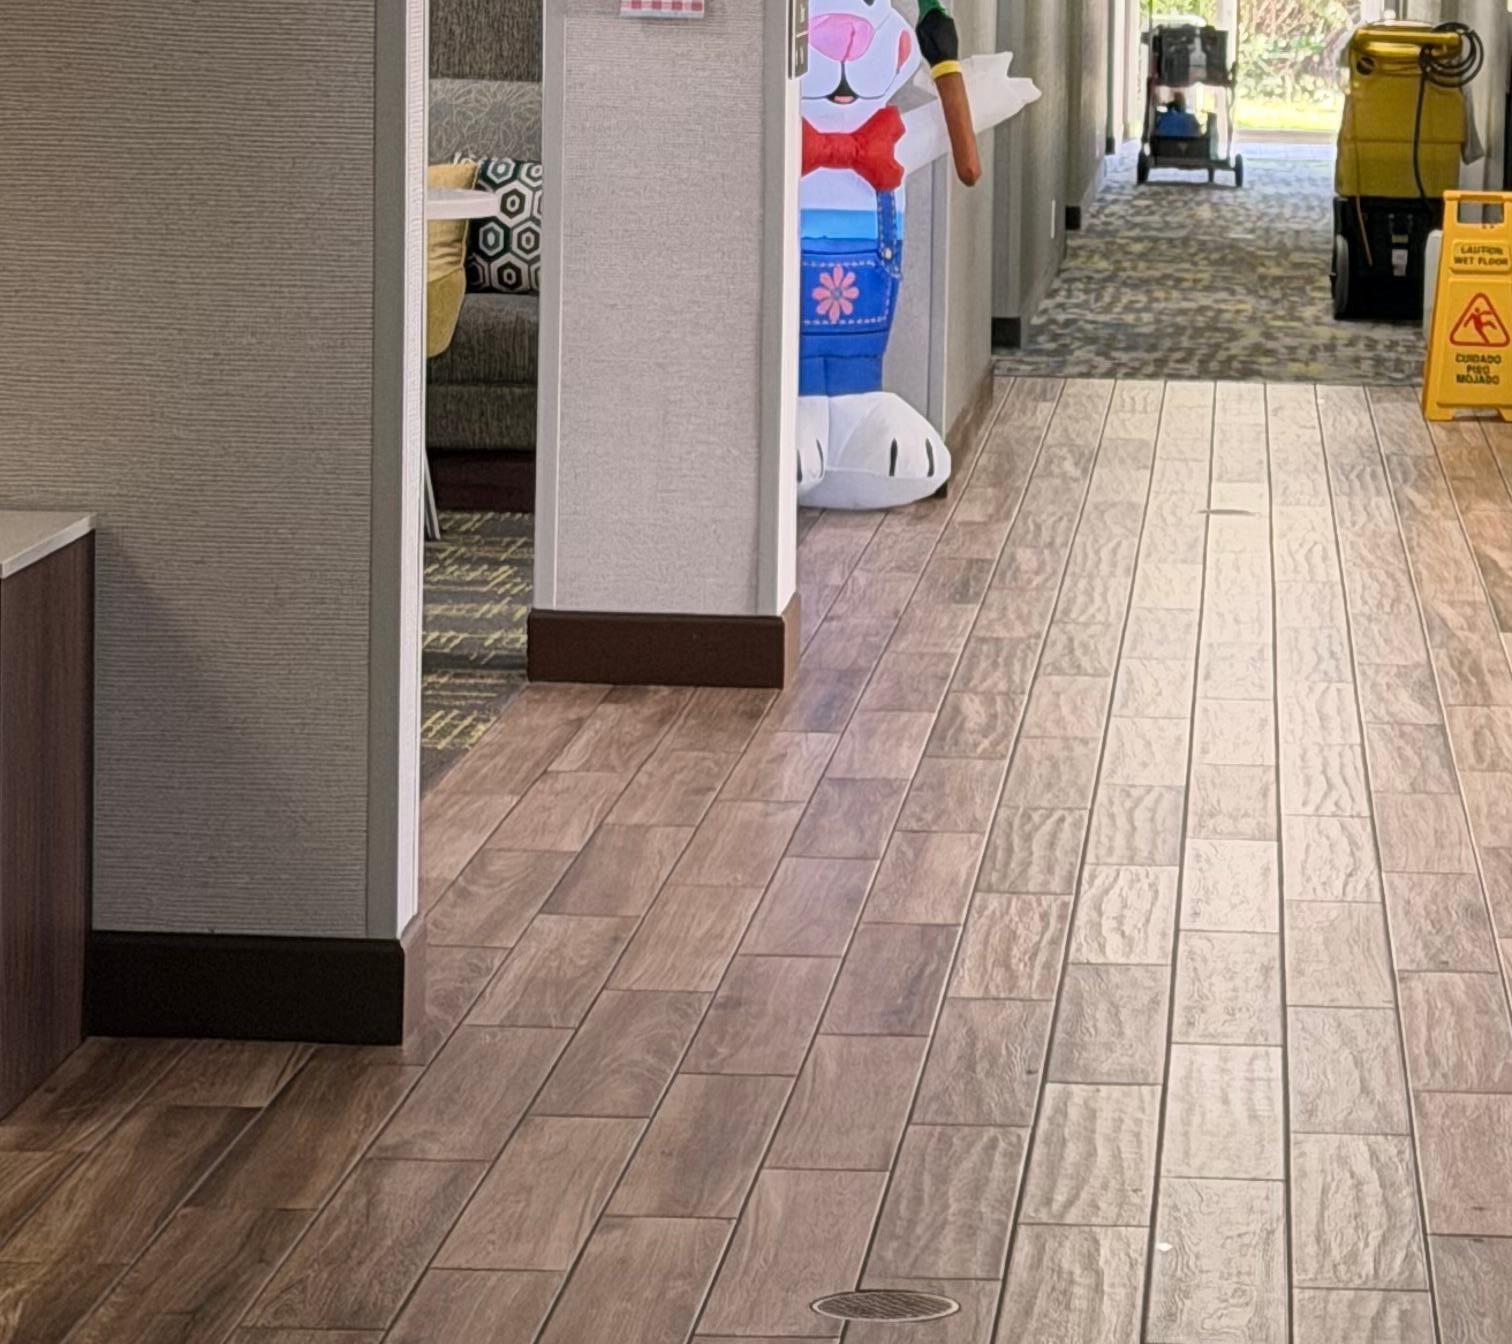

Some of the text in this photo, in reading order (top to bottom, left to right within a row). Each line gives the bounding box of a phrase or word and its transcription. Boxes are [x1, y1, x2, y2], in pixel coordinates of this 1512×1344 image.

[1454, 256, 1509, 266] WET FLOOR
[1455, 352, 1502, 364] CUIDADO
[1466, 364, 1490, 375] PISO
[1456, 374, 1500, 385] MOJADO
